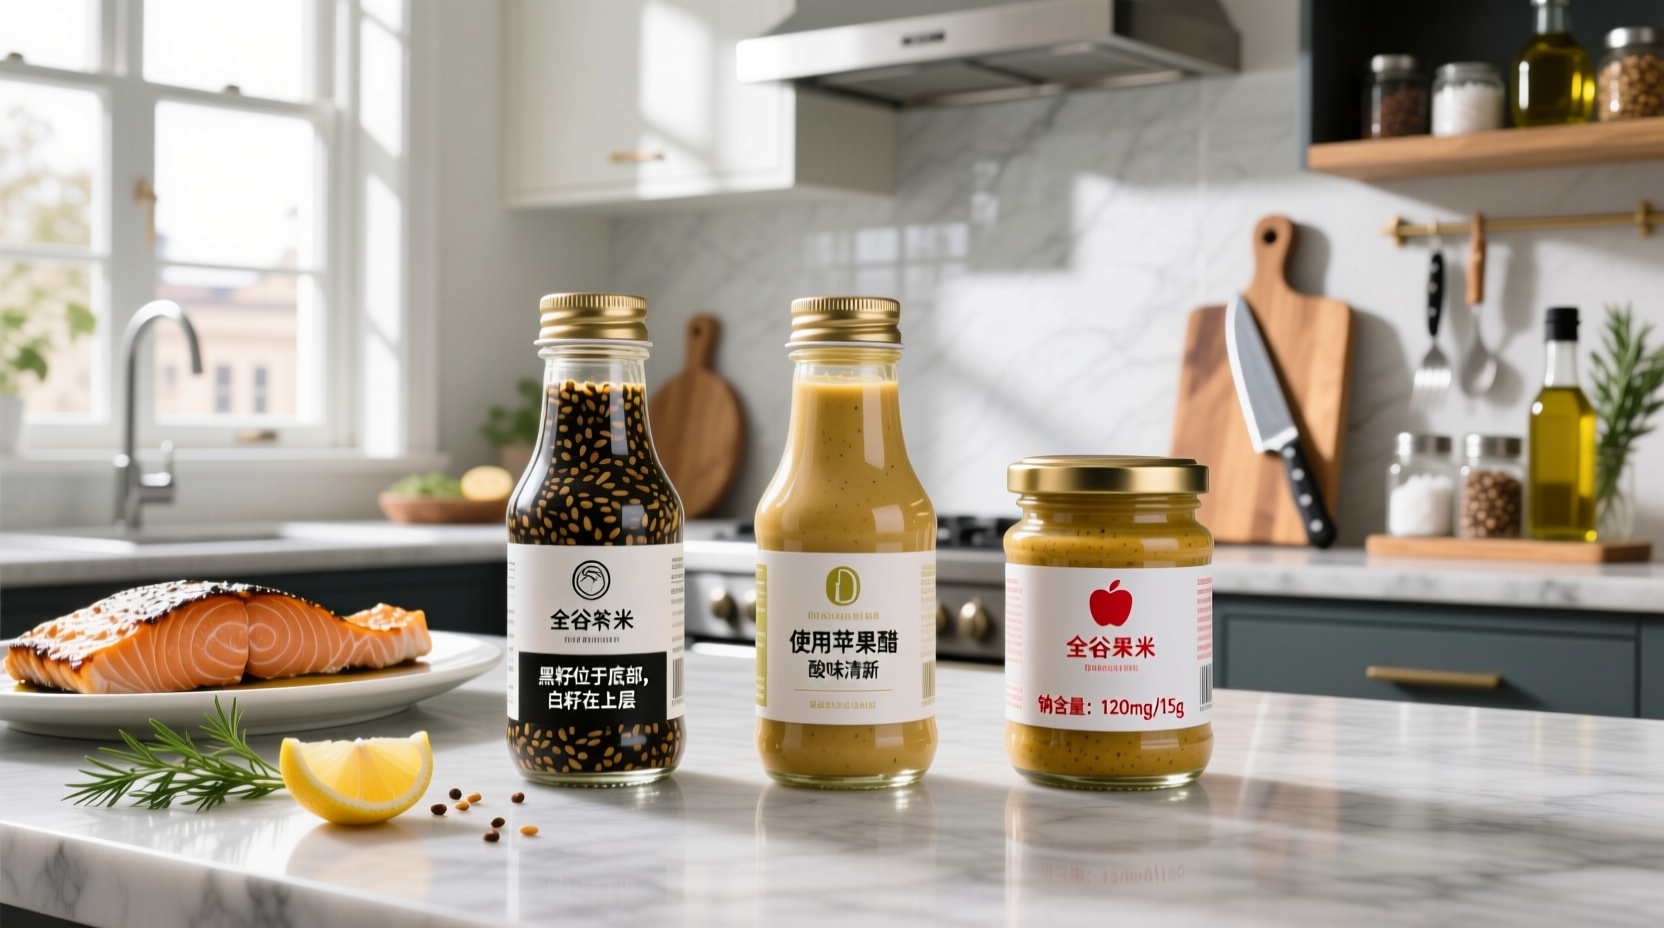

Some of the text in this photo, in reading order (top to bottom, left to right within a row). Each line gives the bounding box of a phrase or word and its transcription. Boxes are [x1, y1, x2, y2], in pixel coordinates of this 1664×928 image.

[789, 629, 899, 654] 使用苹果醋
[807, 659, 880, 680] 酸味清新
[548, 690, 637, 711] 白籽在上层
